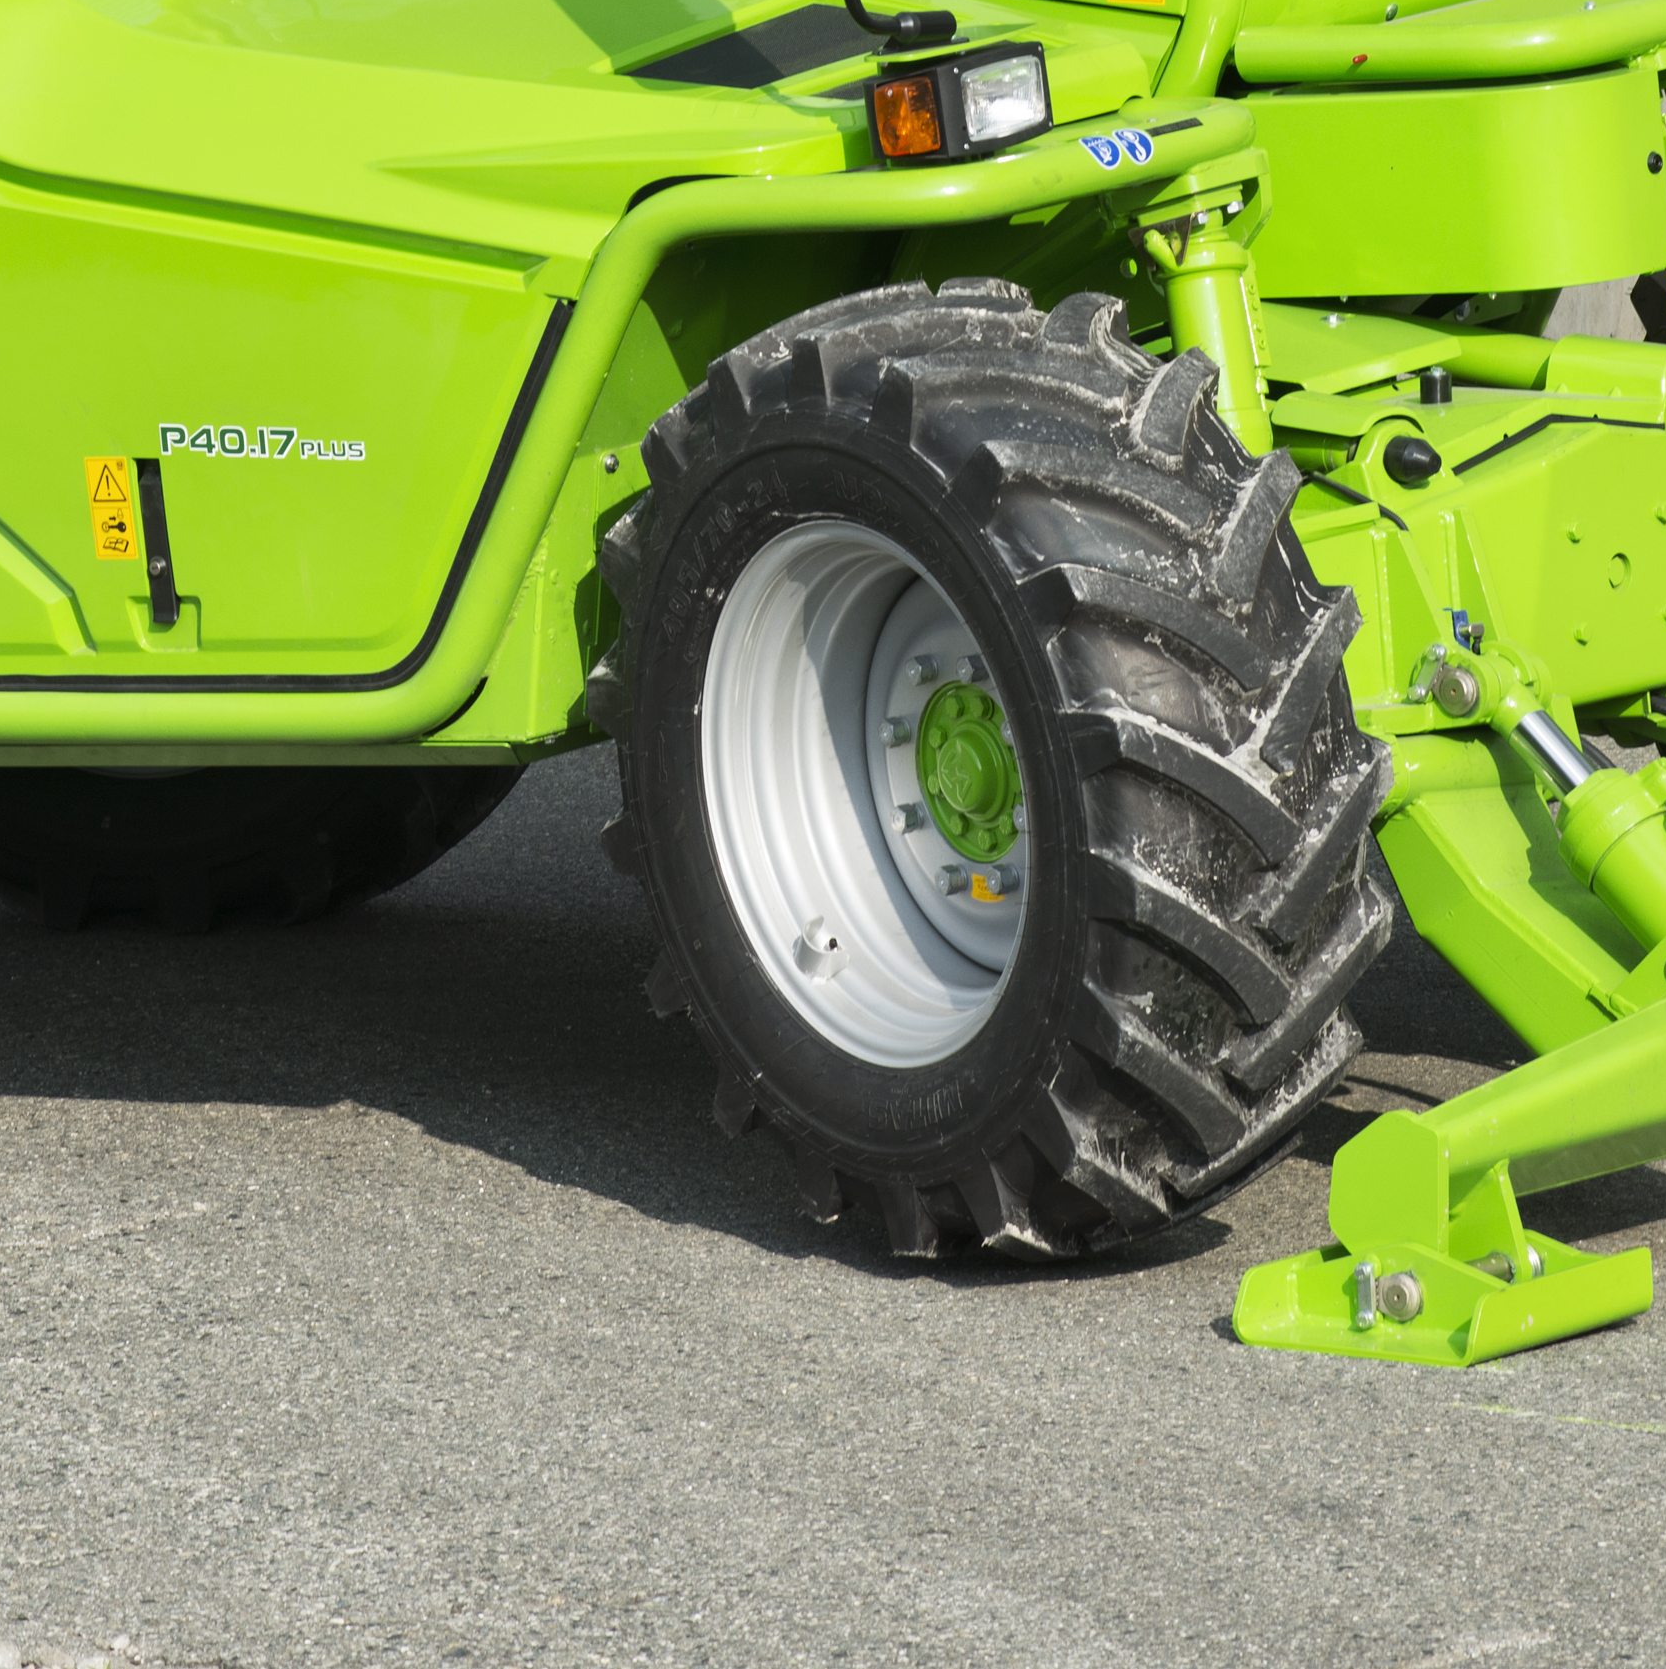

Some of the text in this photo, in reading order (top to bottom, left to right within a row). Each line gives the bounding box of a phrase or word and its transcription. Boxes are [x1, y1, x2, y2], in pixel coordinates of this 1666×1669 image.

[159, 423, 365, 460] P40.17 PLUS
[661, 469, 789, 644] 405/70-24
